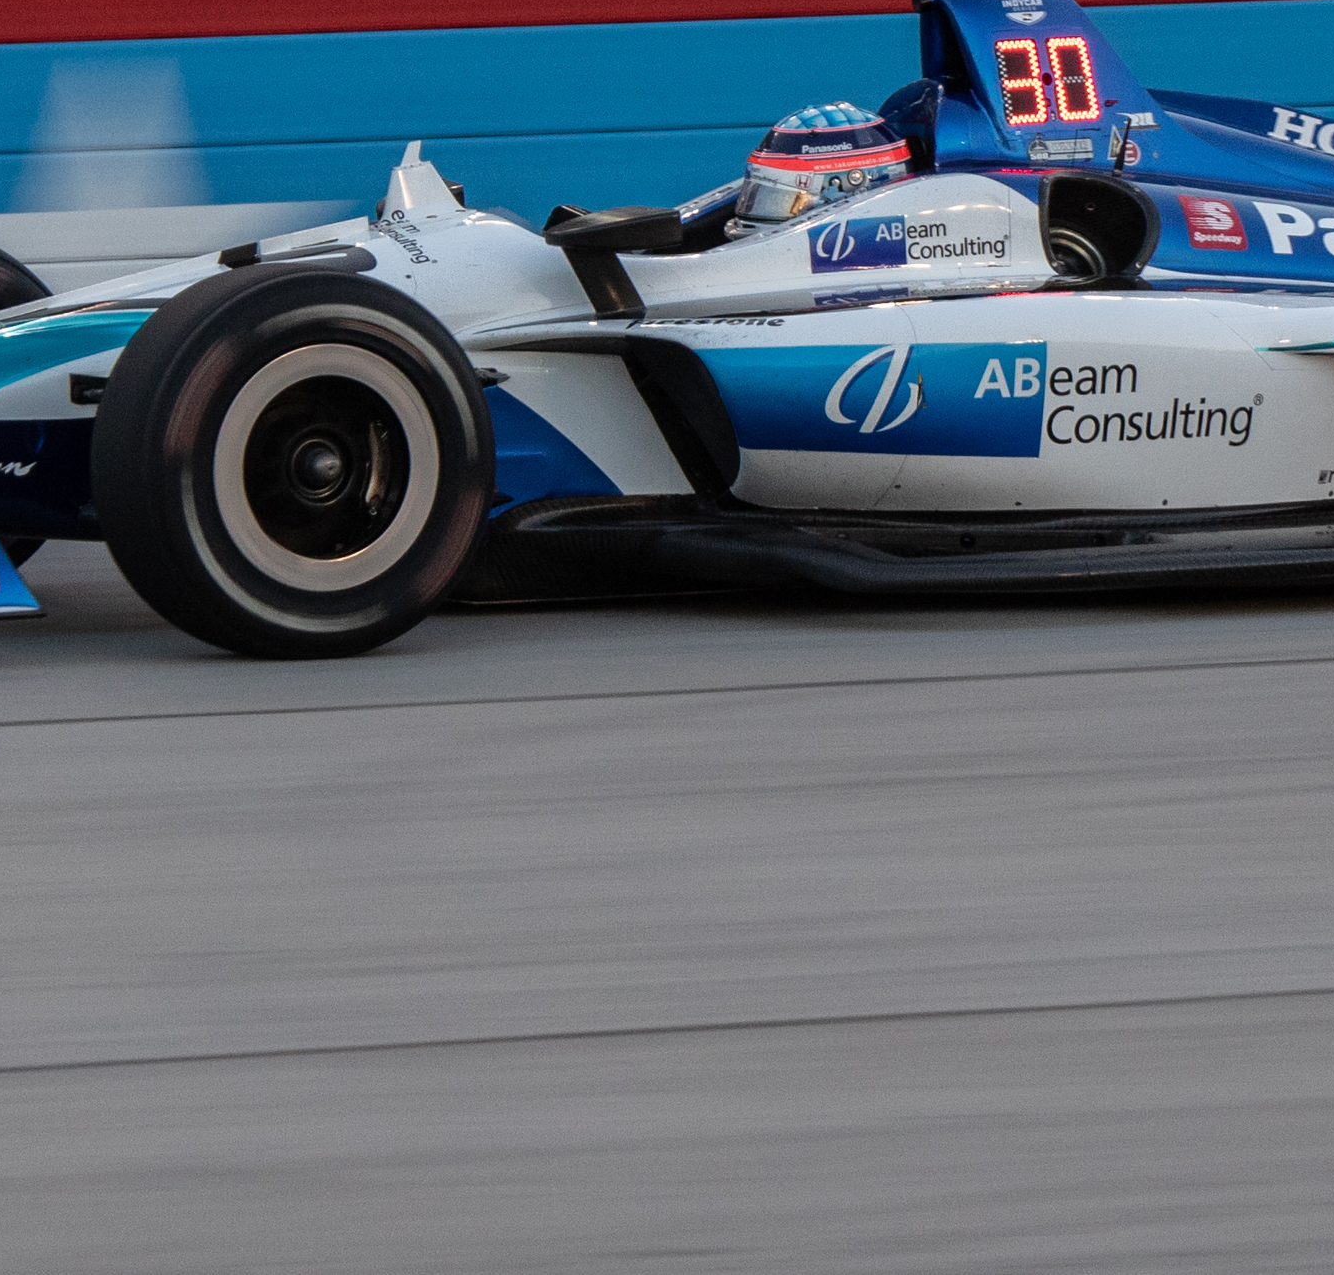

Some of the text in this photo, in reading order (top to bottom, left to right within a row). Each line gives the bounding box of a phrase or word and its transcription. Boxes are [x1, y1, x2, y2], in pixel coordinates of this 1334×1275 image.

[995, 36, 1100, 125] 30
[801, 142, 853, 154] Panasonic
[1193, 231, 1242, 245] Speedway
